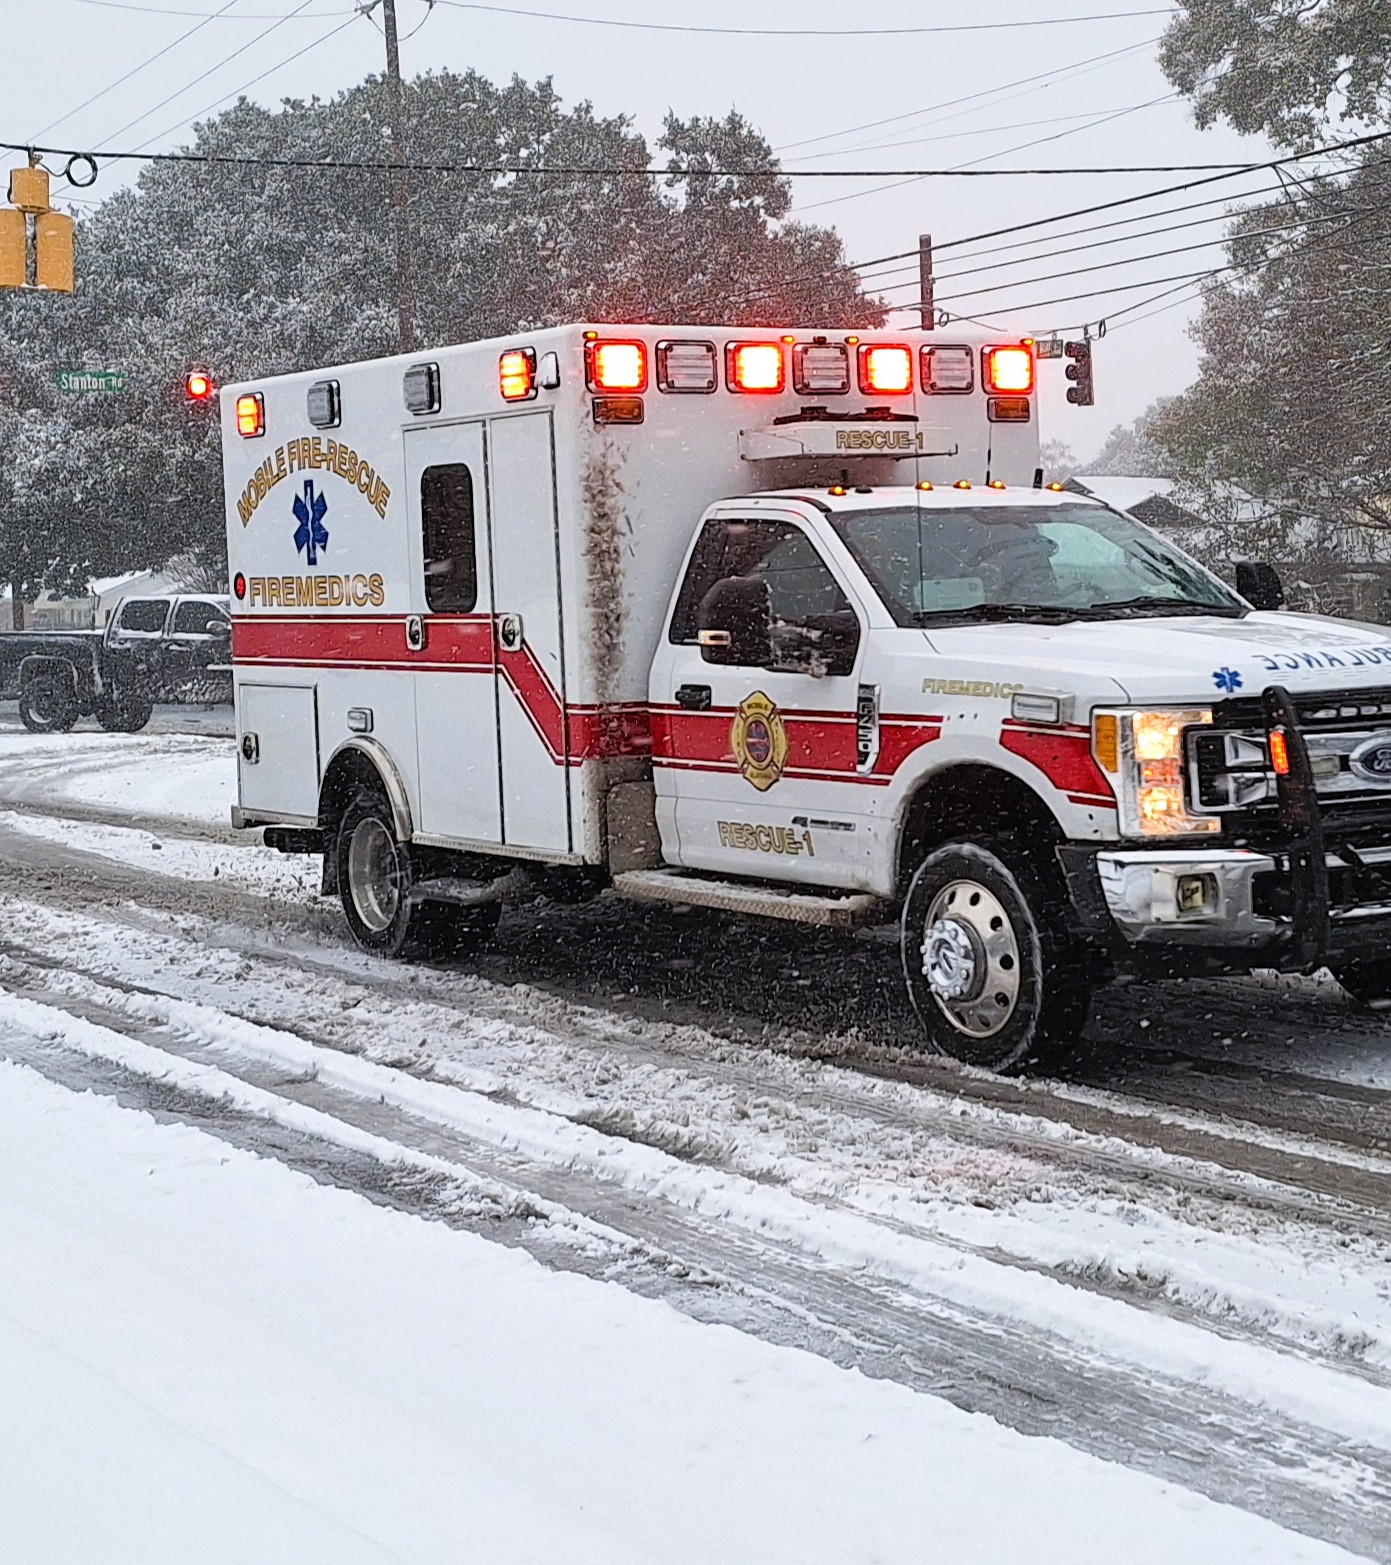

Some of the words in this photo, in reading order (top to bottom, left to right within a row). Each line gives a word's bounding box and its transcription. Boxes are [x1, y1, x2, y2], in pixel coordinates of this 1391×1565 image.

[61, 373, 106, 390] Stanton
[836, 430, 924, 450] RESCUE-1
[237, 446, 288, 528] MOBILE
[287, 436, 391, 520] FIRE-RESCUE
[249, 573, 386, 608] FIREMEDICS
[717, 820, 815, 857] RESCUE-1
